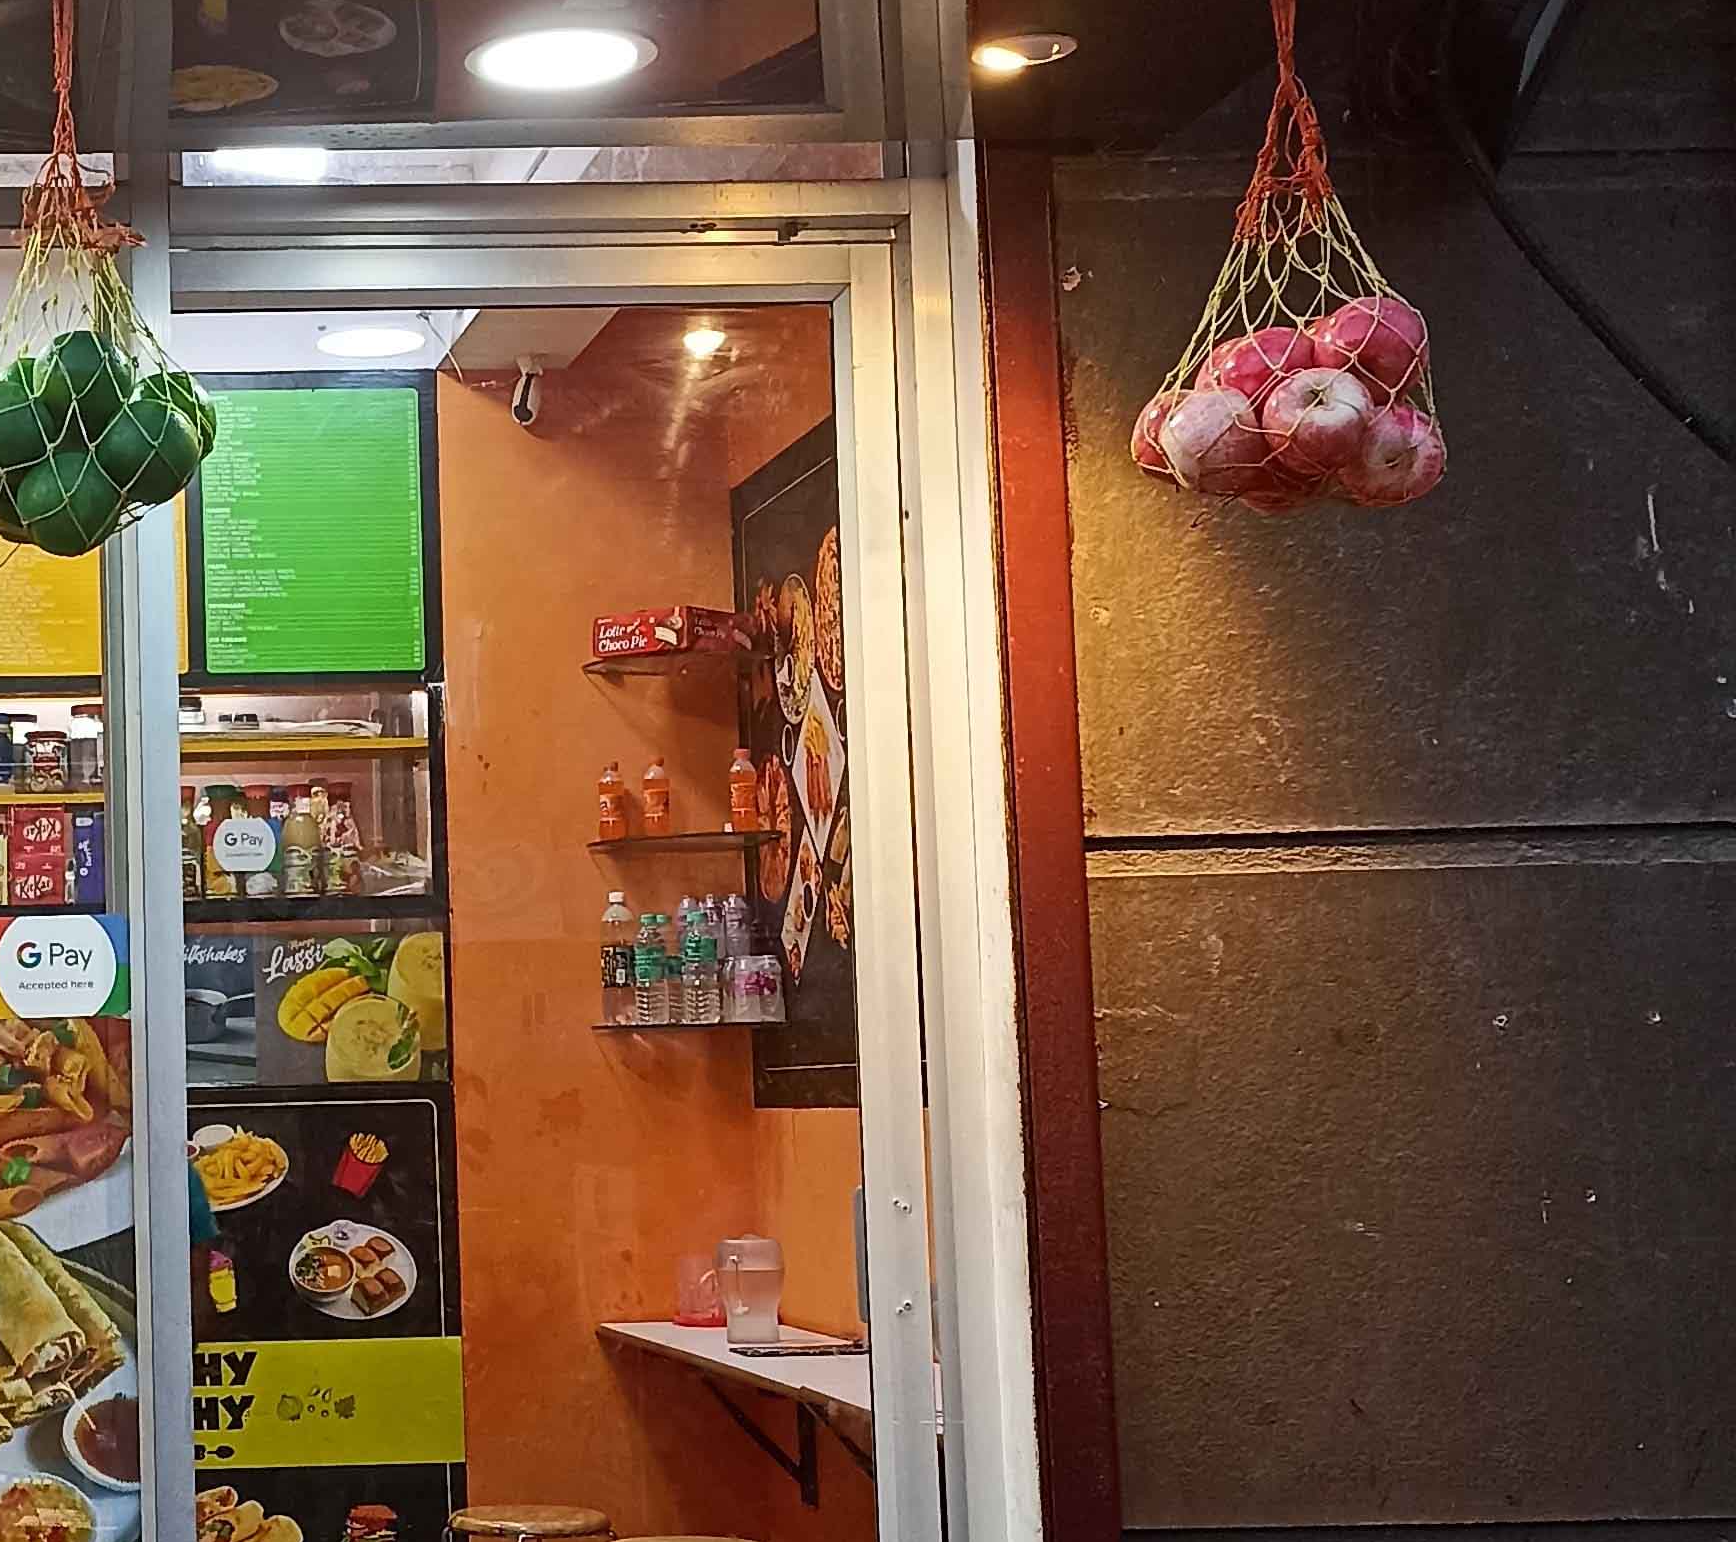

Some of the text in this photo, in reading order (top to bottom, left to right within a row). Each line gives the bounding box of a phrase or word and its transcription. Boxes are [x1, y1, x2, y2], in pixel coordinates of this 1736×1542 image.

[241, 832, 264, 848] Pay
[16, 941, 93, 971] G Pay
[184, 944, 247, 965] ilkshakes
[262, 944, 325, 984] Lassi
[18, 980, 94, 991] Accepted here
